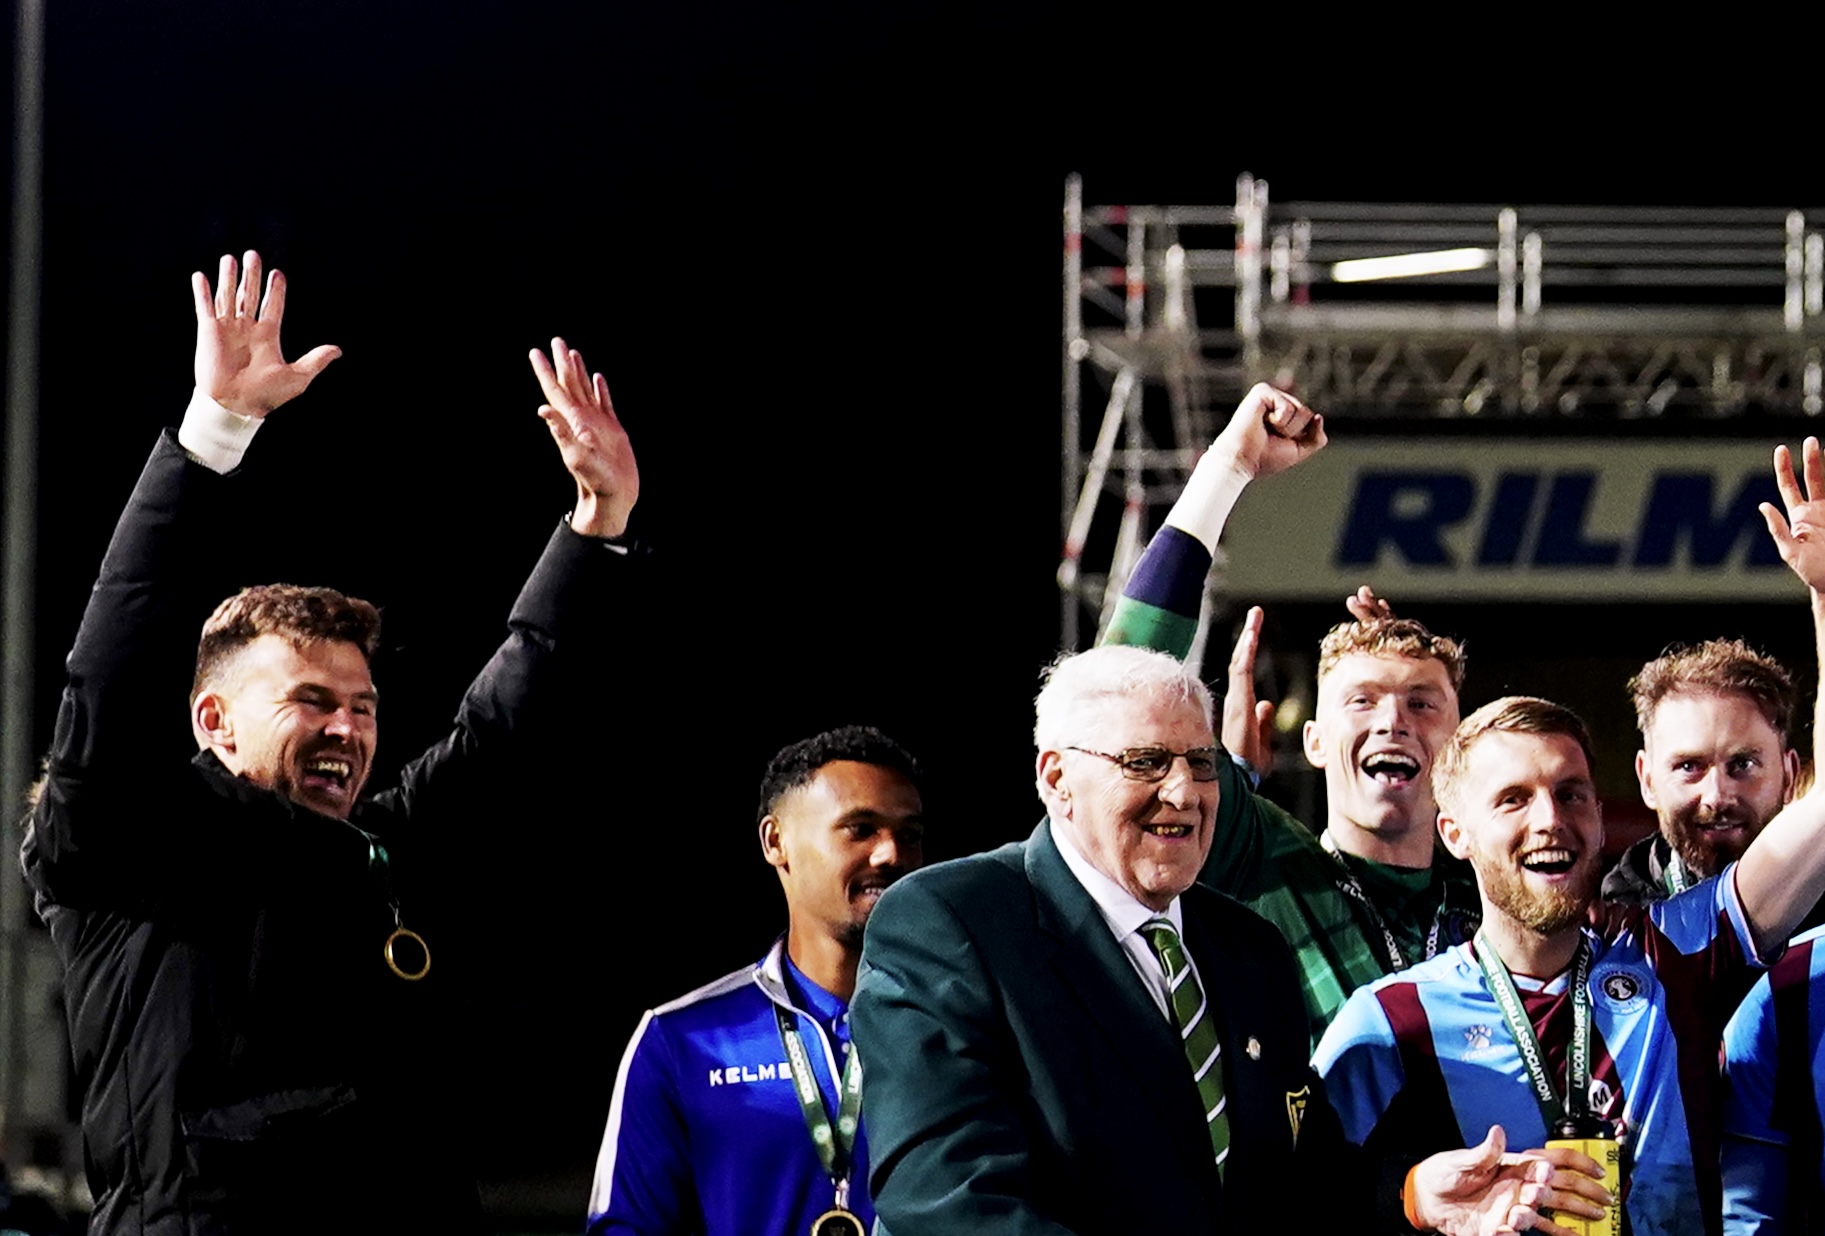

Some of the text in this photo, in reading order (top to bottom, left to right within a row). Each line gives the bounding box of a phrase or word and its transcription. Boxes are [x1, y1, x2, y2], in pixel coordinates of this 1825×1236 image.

[709, 1062, 794, 1087] KELME
[1490, 973, 1552, 1101] FOOTBALL ASSOCIATION
[1574, 1002, 1586, 1089] LINCOLNSHIRE
